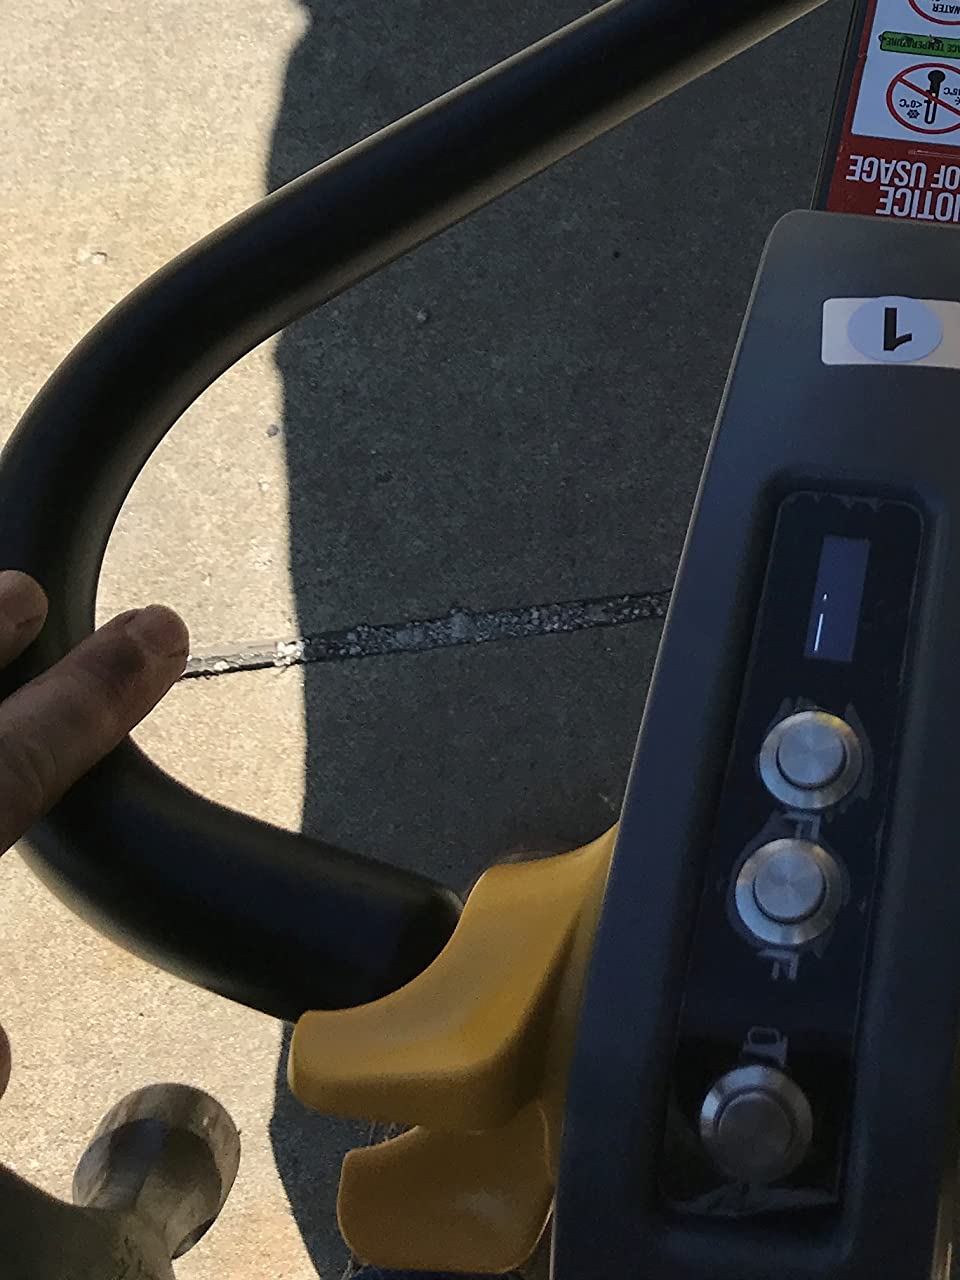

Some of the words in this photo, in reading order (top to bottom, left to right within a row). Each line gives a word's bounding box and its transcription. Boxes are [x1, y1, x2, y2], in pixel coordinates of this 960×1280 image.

[846, 155, 927, 188] USAGE
[931, 165, 960, 189] OF
[883, 307, 912, 351] 1
